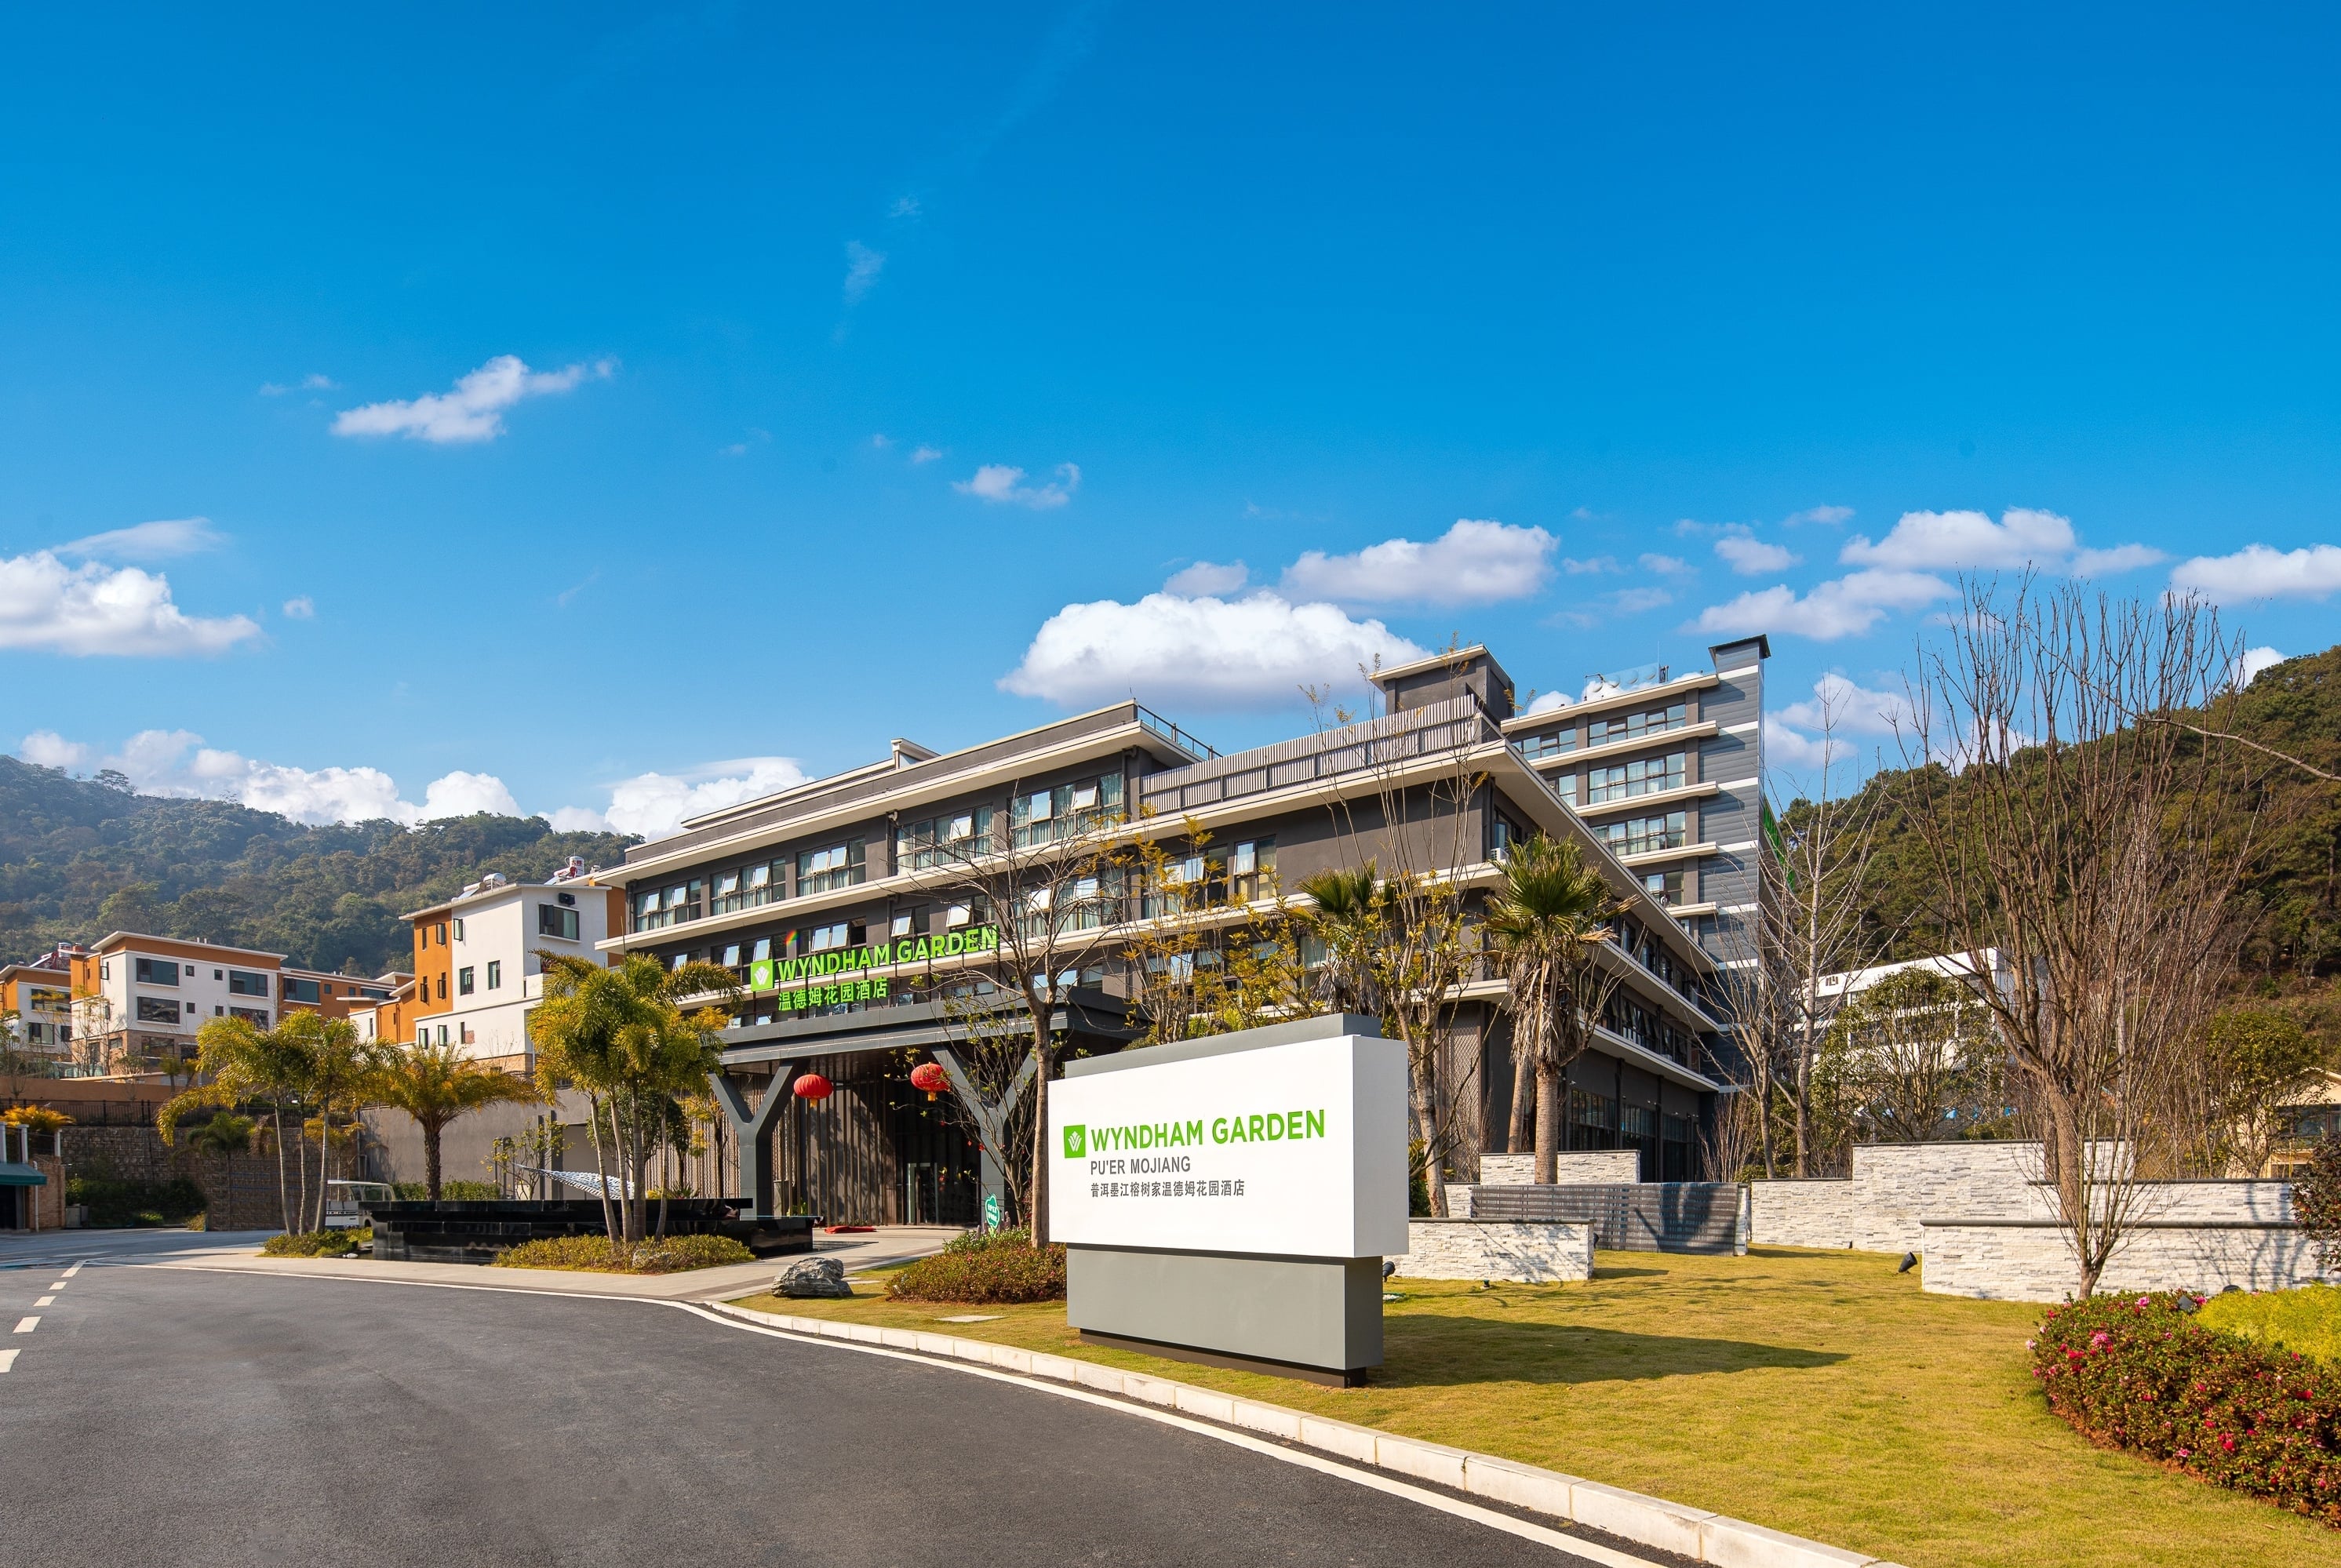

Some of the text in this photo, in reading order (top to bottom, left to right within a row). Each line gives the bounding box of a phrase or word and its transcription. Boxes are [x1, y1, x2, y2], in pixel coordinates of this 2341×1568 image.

[778, 925, 999, 982] WYNDHAM GARDEN
[778, 977, 888, 1011] 温德姆花园酒店
[1090, 1109, 1324, 1152] WYNDHAM GARDEN
[1090, 1155, 1191, 1176] PU'ER MOJIANG
[1090, 1179, 1244, 1198] 普洱墨江榕树家温德姆花园酒店
